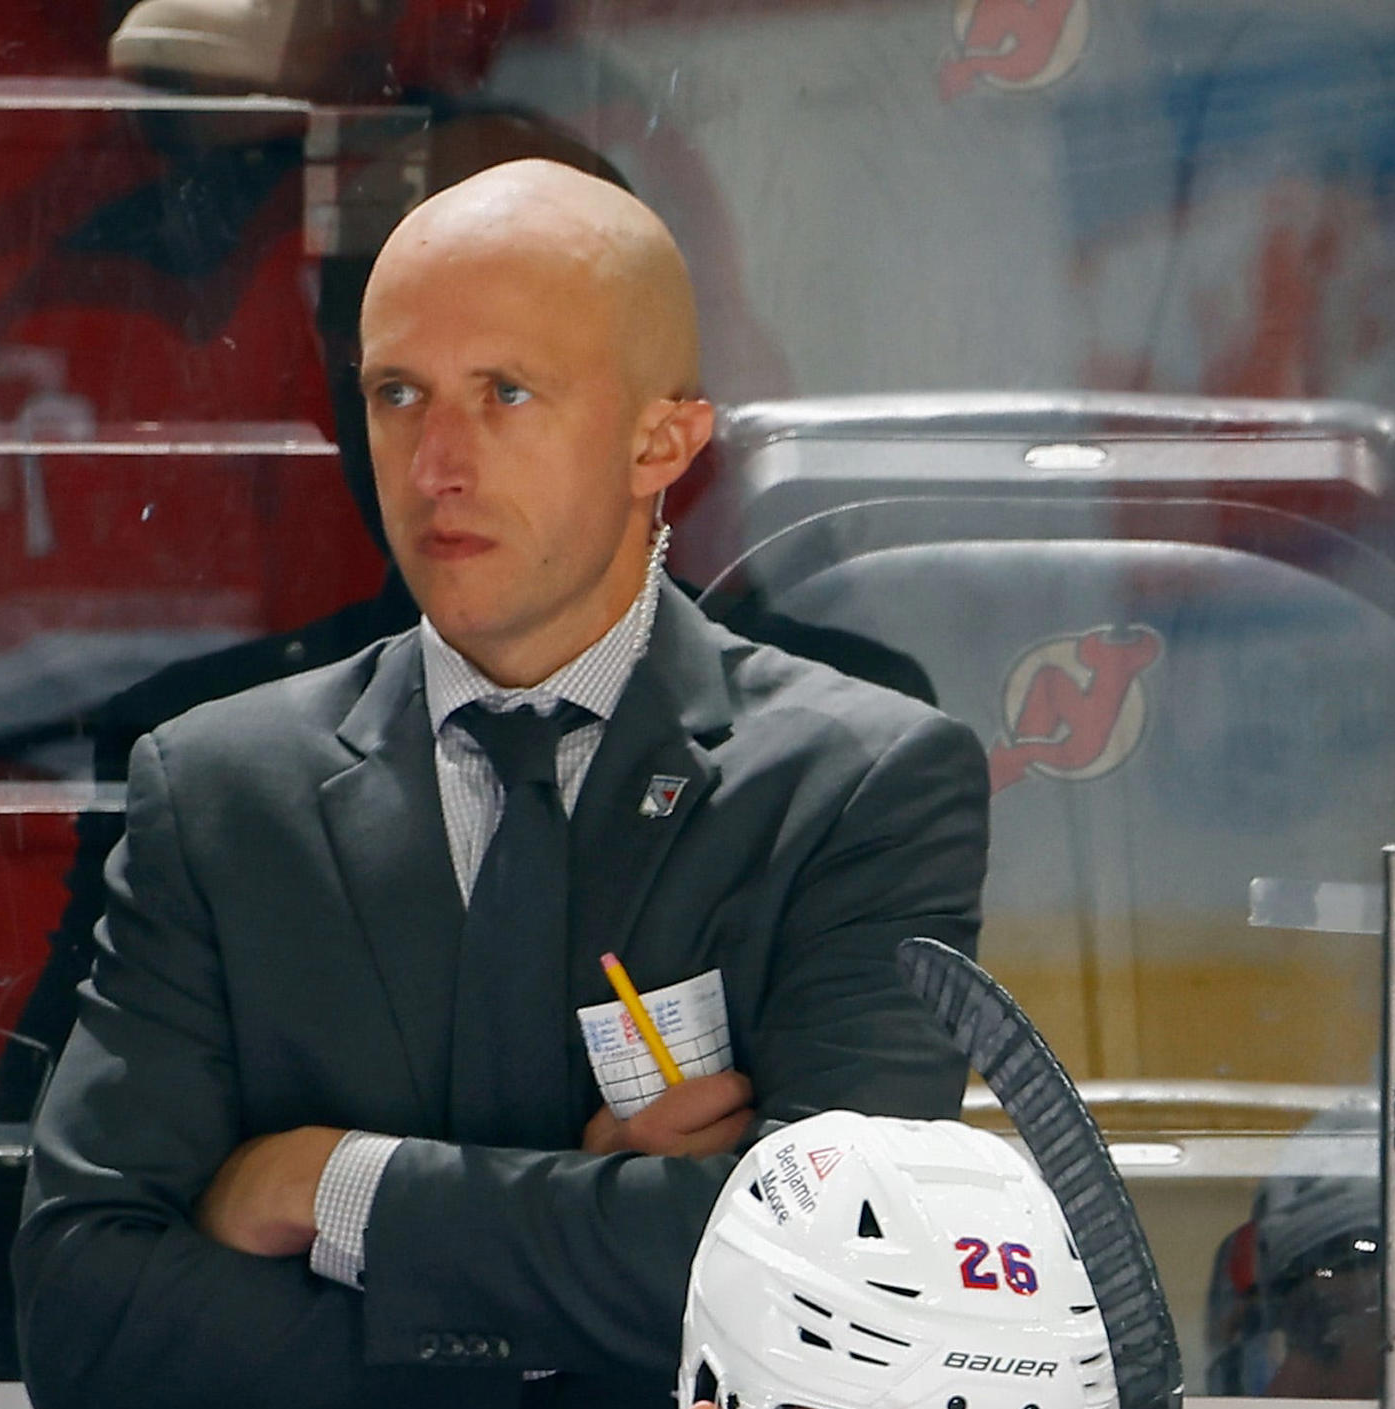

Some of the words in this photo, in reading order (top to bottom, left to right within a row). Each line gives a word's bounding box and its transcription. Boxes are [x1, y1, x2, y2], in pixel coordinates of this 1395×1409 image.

[761, 1168, 790, 1226] Moore
[776, 1143, 819, 1214] Benjamin
[954, 1237, 1039, 1296] 26
[943, 1351, 1059, 1378] BAUER
